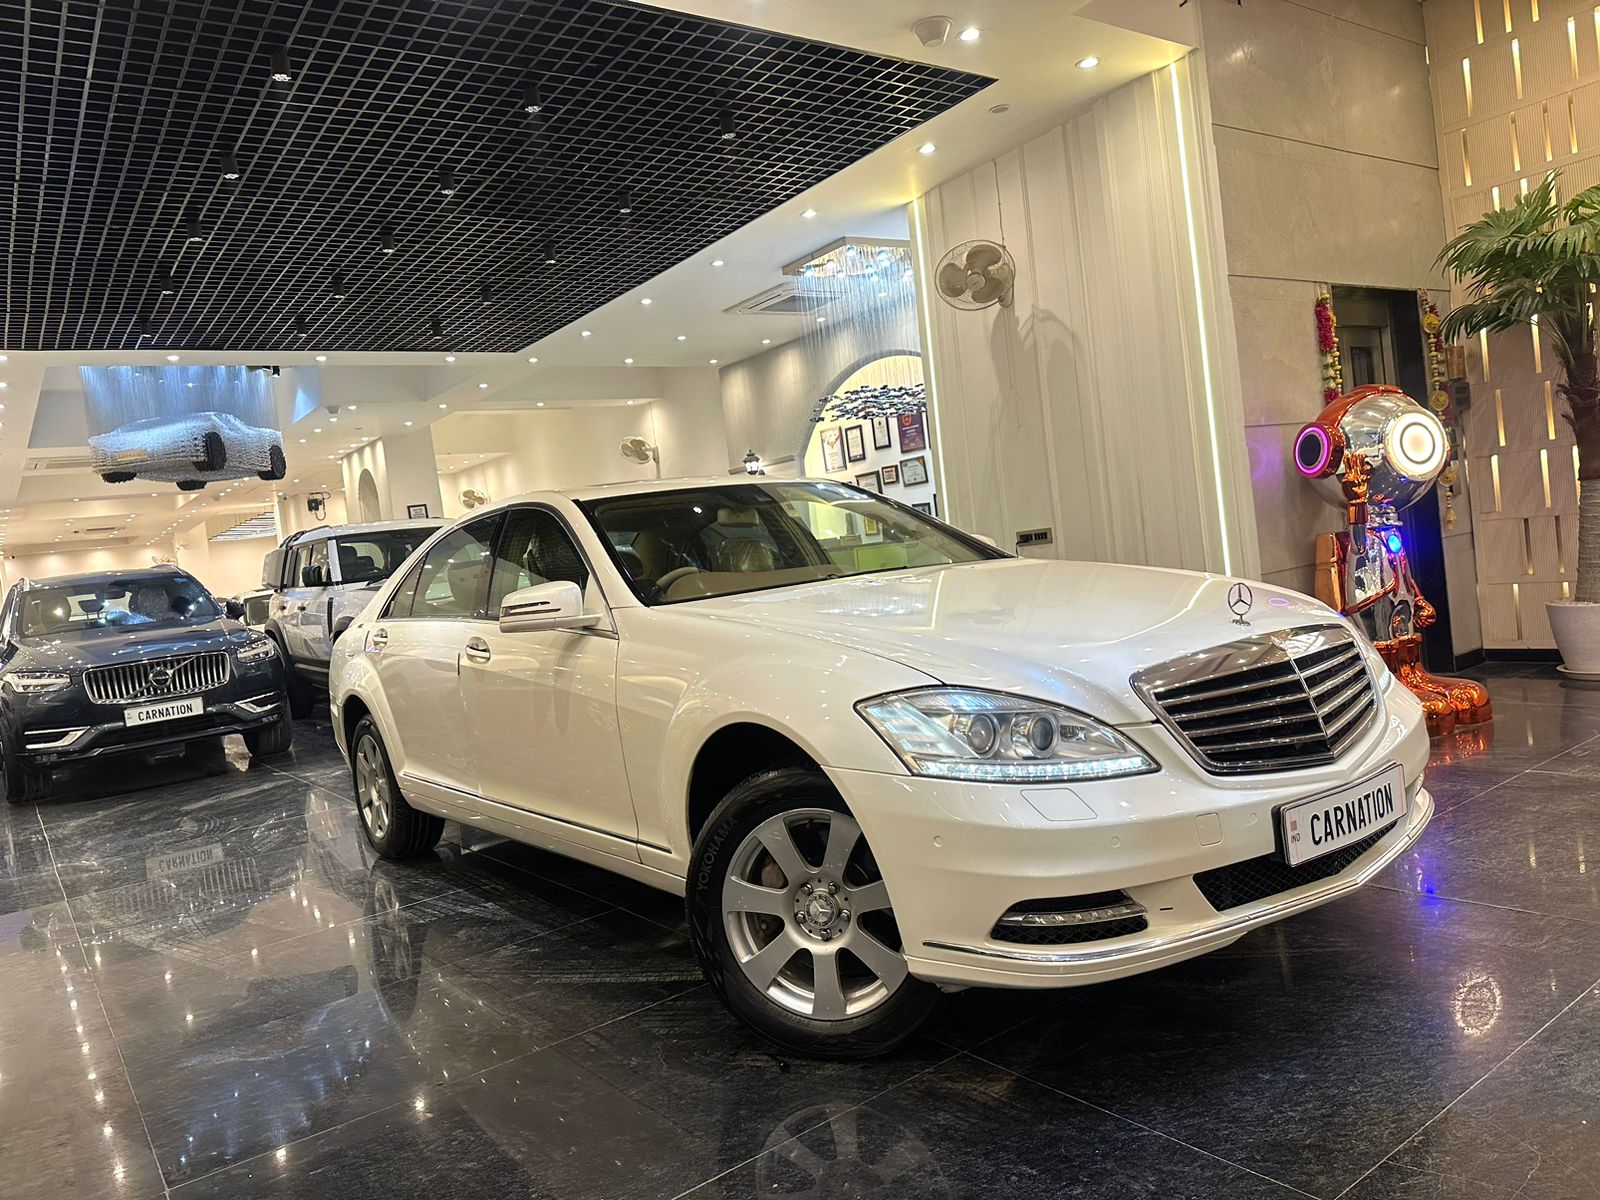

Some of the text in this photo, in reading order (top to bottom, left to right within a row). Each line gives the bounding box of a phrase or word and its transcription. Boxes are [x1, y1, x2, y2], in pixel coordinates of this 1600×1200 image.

[137, 703, 193, 722] CARNATION
[1310, 782, 1394, 846] CARNATION
[697, 815, 739, 891] YOKOHAMA
